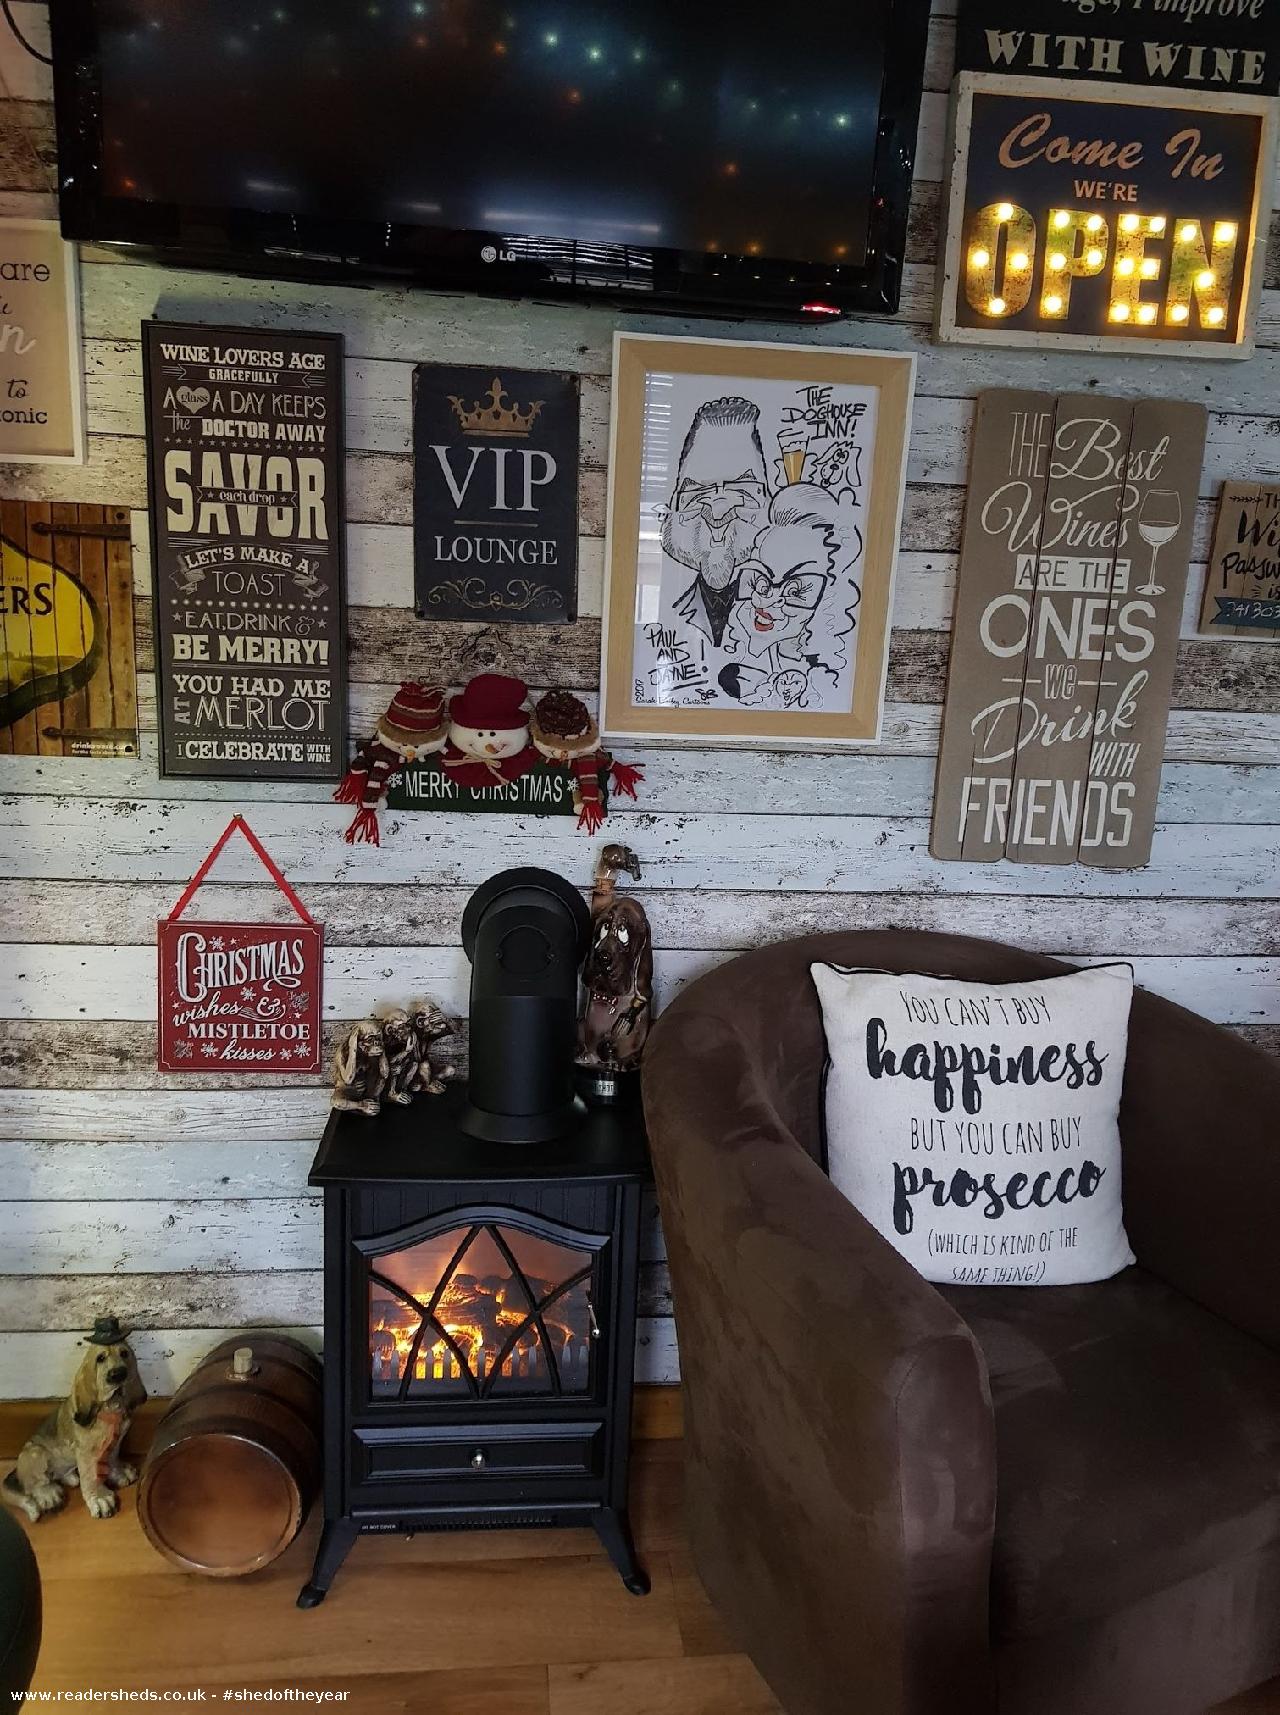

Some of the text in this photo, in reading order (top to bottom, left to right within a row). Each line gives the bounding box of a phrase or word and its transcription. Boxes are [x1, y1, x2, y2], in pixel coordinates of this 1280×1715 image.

[984, 29, 1267, 85] WITH WINE
[999, 113, 1225, 181] Come In
[1074, 179, 1138, 202] WE'RE
[500, 250, 516, 261] LG
[965, 202, 1239, 330] OPEN
[0, 262, 50, 282] are
[160, 343, 326, 370] WINE LOVERS AGE
[7, 379, 27, 398] to
[209, 368, 279, 384] GRACEFULLY
[163, 387, 177, 409] A
[212, 390, 225, 413] A
[231, 390, 266, 415] DAY
[272, 393, 327, 420] KEEPS
[796, 386, 833, 407] THE
[0, 407, 48, 424] onic
[163, 410, 326, 443] the DOCTOR AWAY
[781, 403, 867, 423] DOGHOUSE
[807, 419, 858, 440] INN!
[1008, 412, 1170, 481] THE Best
[428, 444, 557, 512] VIP
[164, 450, 329, 540] SAVOR
[219, 490, 276, 505] each drop
[981, 481, 1140, 552] Wines
[1237, 510, 1280, 557] Wi
[185, 547, 312, 575] LET'S MAKE A
[434, 535, 558, 565] LOUNGE
[212, 571, 286, 597] TOAST
[1019, 559, 1128, 590] ARE THE
[295, 615, 316, 636] &
[643, 623, 688, 648] PAUL
[980, 594, 1156, 663] ONES
[172, 633, 329, 666] BE MERRY!
[656, 648, 690, 665] AND
[172, 674, 331, 698] YOU HAD ME
[174, 696, 331, 732] AT MERLOT
[971, 670, 1149, 764] Drink
[185, 740, 303, 762] CELEBRATE
[306, 744, 331, 754] WITH
[306, 753, 331, 763] WINE
[1089, 741, 1141, 777] WITH
[958, 777, 1136, 847] FRIENDS
[173, 991, 282, 1027] wishes &
[900, 991, 1051, 1026] YOU CAN'T BUY
[187, 1023, 310, 1040] MISTLETOE
[219, 1039, 276, 1061] kisses
[866, 1017, 1110, 1114] happiness
[910, 1116, 1081, 1155] BUT YOU CAN BUY
[892, 1160, 1106, 1235] prosecco
[928, 1227, 1078, 1257] (WHICH IS KIND OF THE
[952, 1261, 1047, 1283] SAME THING!)
